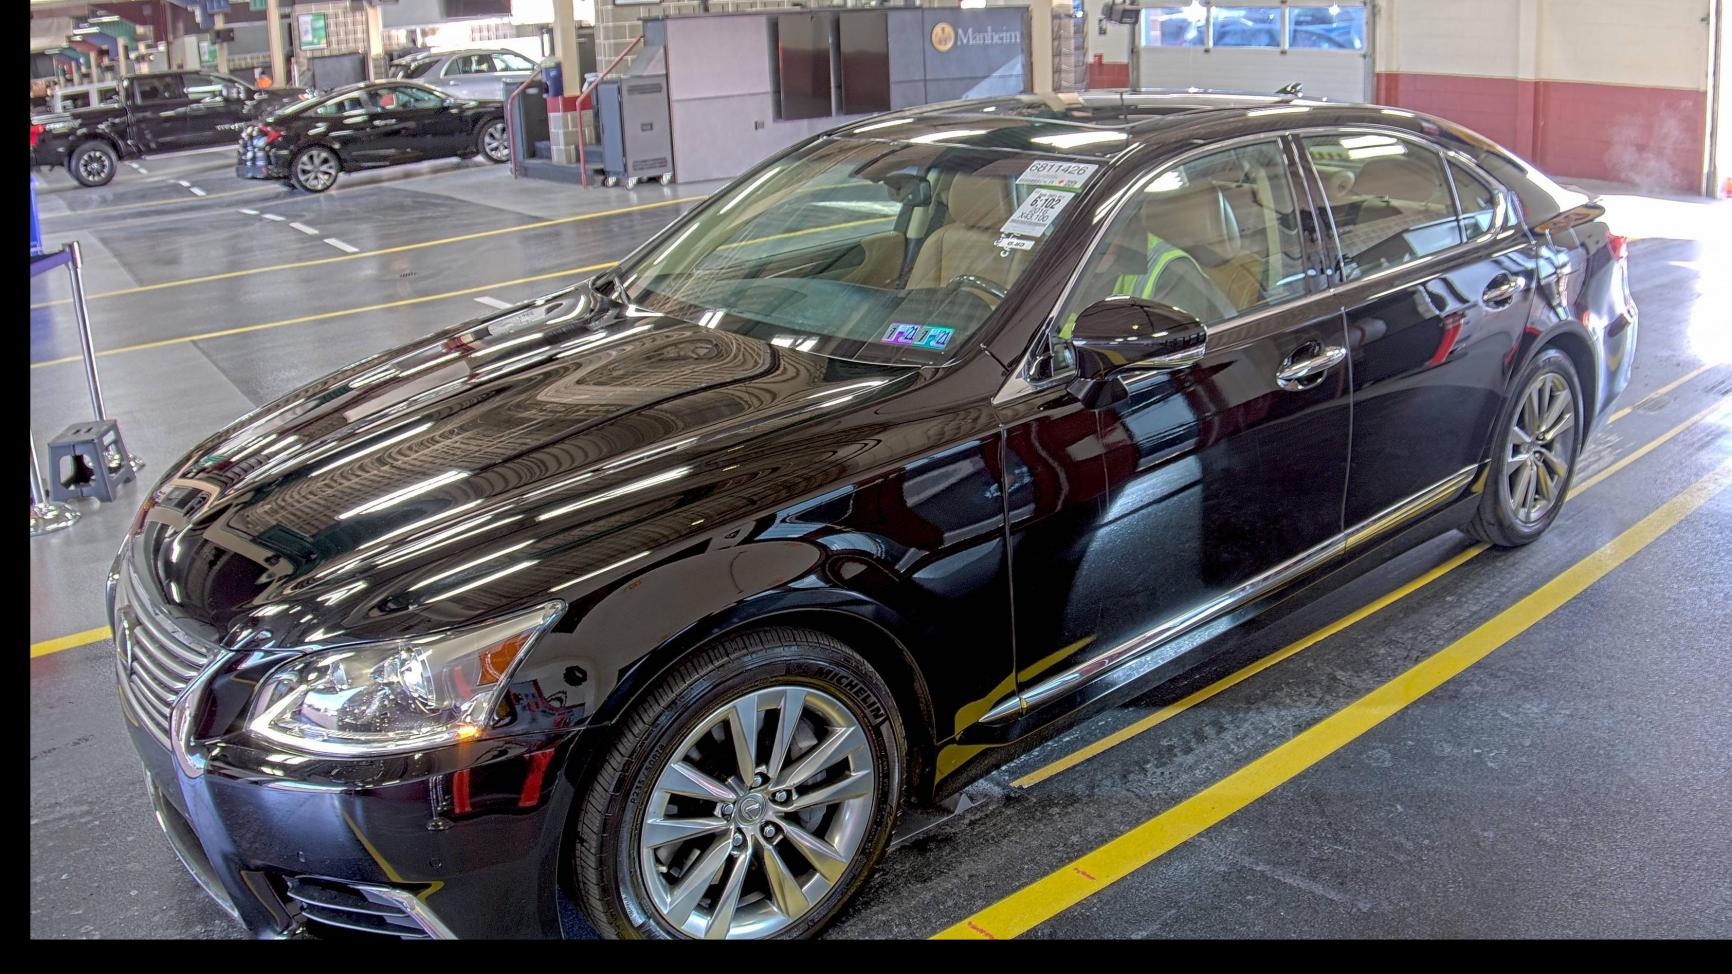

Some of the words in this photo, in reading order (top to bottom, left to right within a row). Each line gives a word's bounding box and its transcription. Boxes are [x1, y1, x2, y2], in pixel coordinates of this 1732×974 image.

[957, 26, 1020, 45] Manheim
[1029, 163, 1089, 176] 6811426
[816, 665, 887, 726] MICHELIN
